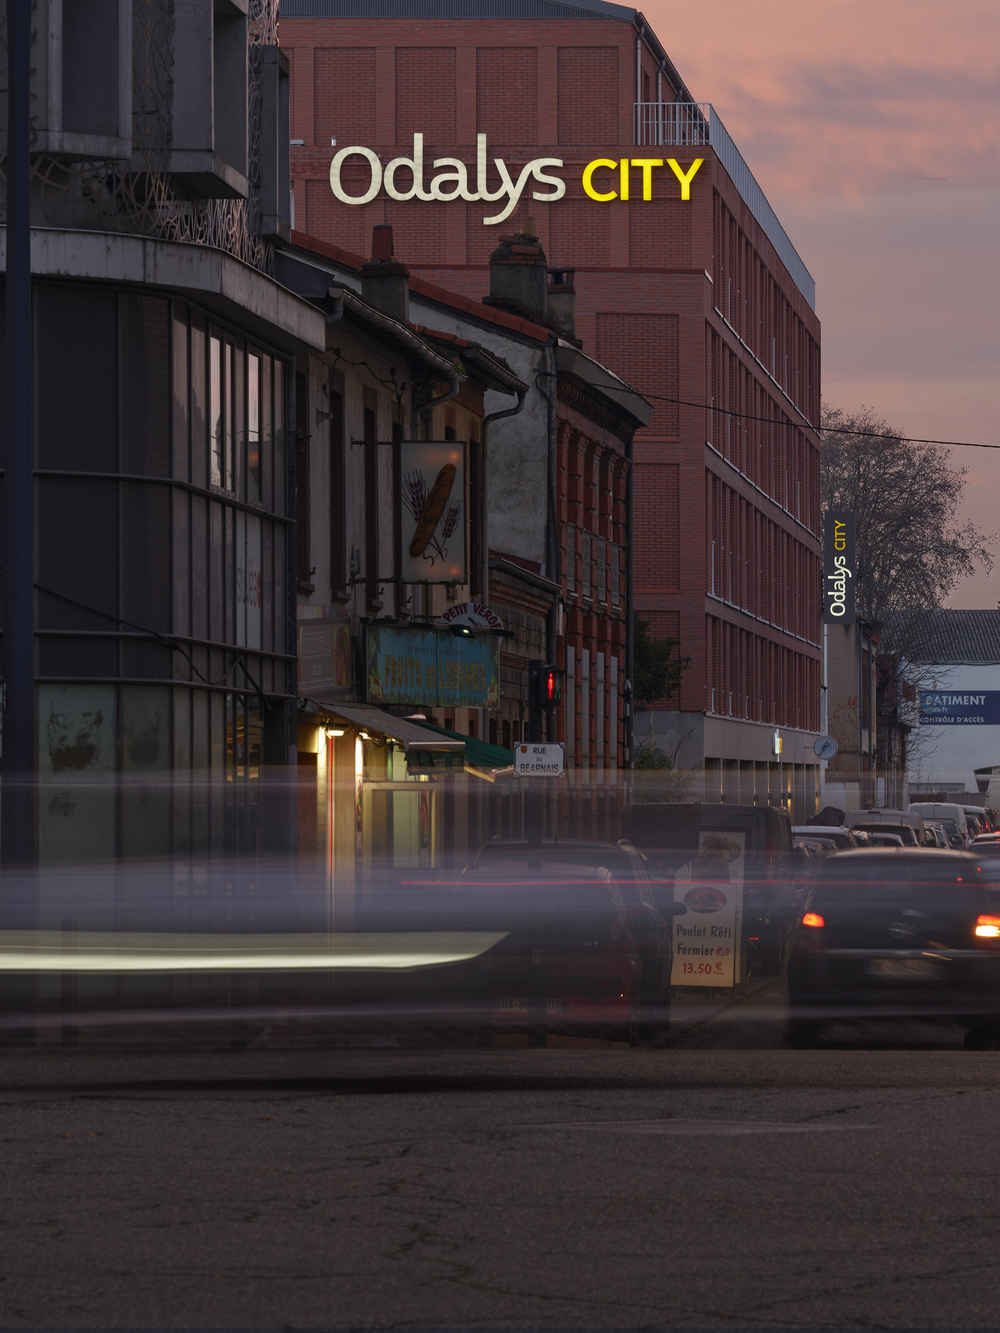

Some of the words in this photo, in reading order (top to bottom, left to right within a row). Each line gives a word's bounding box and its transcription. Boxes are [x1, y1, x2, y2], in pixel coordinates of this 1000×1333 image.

[329, 132, 567, 225] Odalys
[582, 158, 704, 202] CITY
[834, 520, 847, 551] CITY
[828, 556, 852, 617] Odalys
[442, 604, 468, 623] PETIT
[385, 654, 422, 688] FRUITS
[439, 660, 486, 692] LEGUMES
[925, 695, 986, 706] BATIMENT
[520, 763, 559, 773] BÉARNAIS
[676, 924, 706, 938] Poulet
[710, 923, 732, 938] Rôti
[677, 943, 714, 956] Fermier
[683, 962, 711, 974] 13.50
